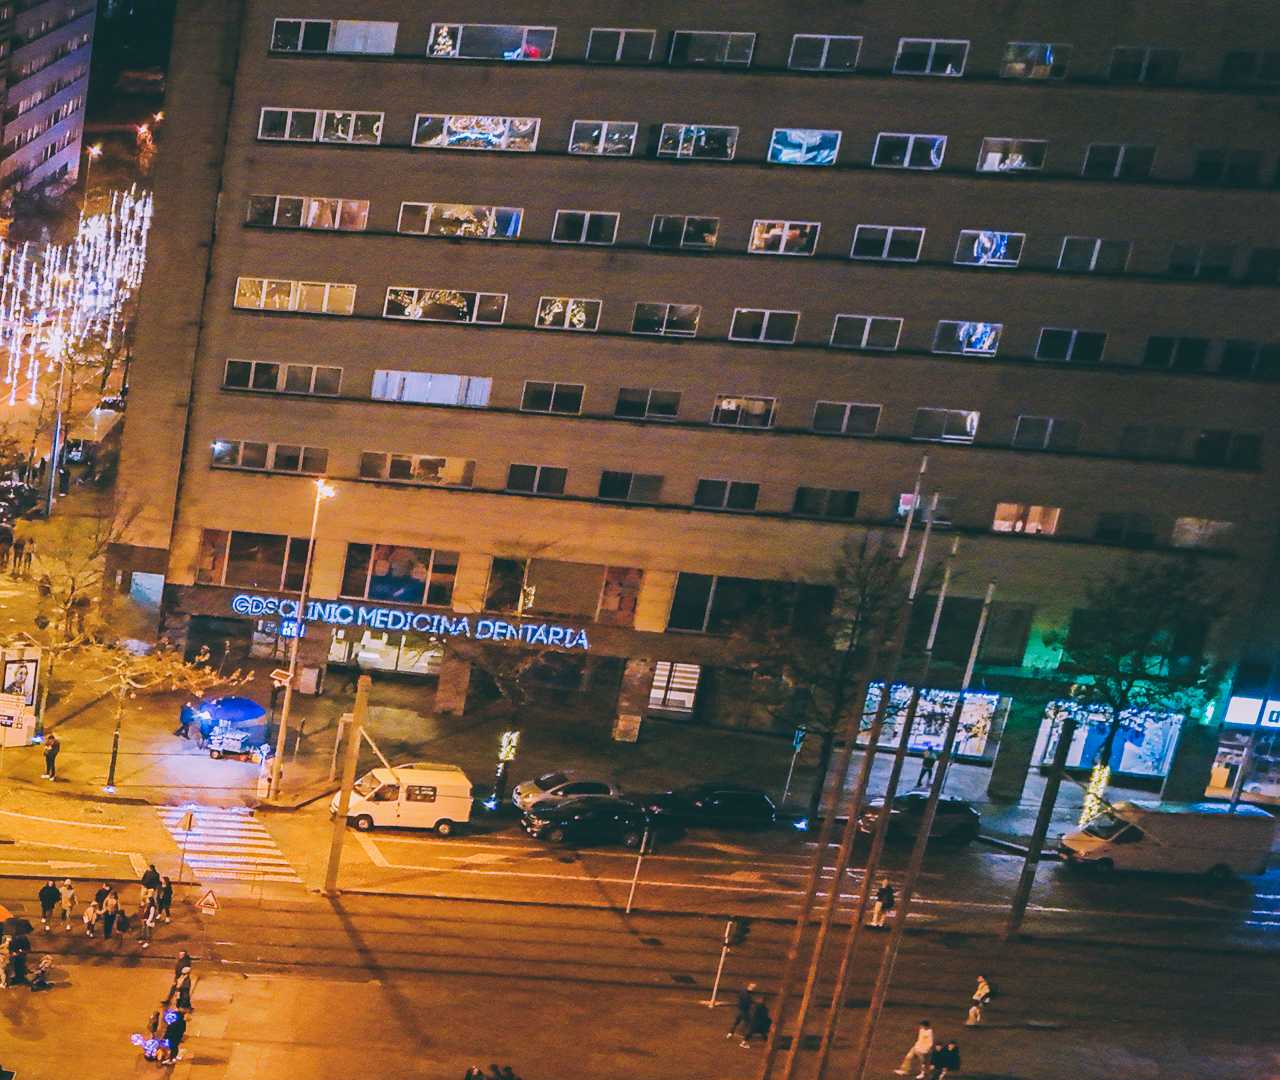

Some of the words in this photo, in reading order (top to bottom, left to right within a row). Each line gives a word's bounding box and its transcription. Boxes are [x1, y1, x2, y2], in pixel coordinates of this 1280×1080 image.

[232, 593, 279, 616] GDS
[278, 599, 354, 625] CLINIC
[356, 605, 471, 638] MEDICINA
